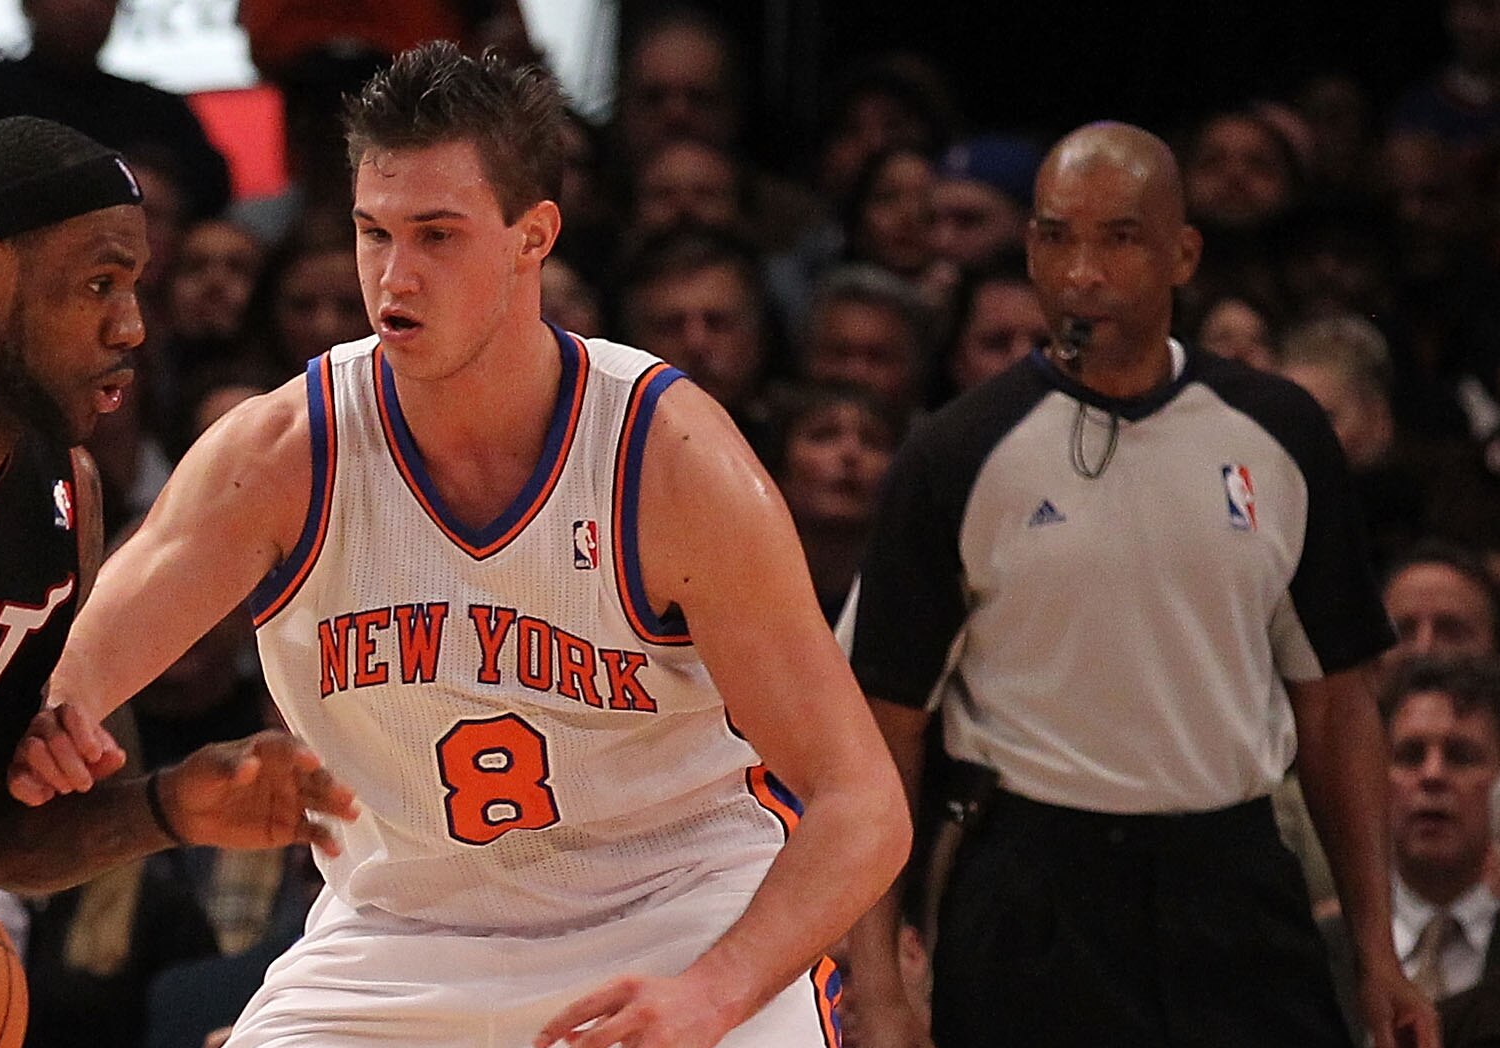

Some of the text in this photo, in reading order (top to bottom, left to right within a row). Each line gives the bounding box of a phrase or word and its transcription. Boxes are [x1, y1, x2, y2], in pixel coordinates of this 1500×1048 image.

[318, 601, 658, 714] NEW YORK
[435, 712, 561, 846] 8
